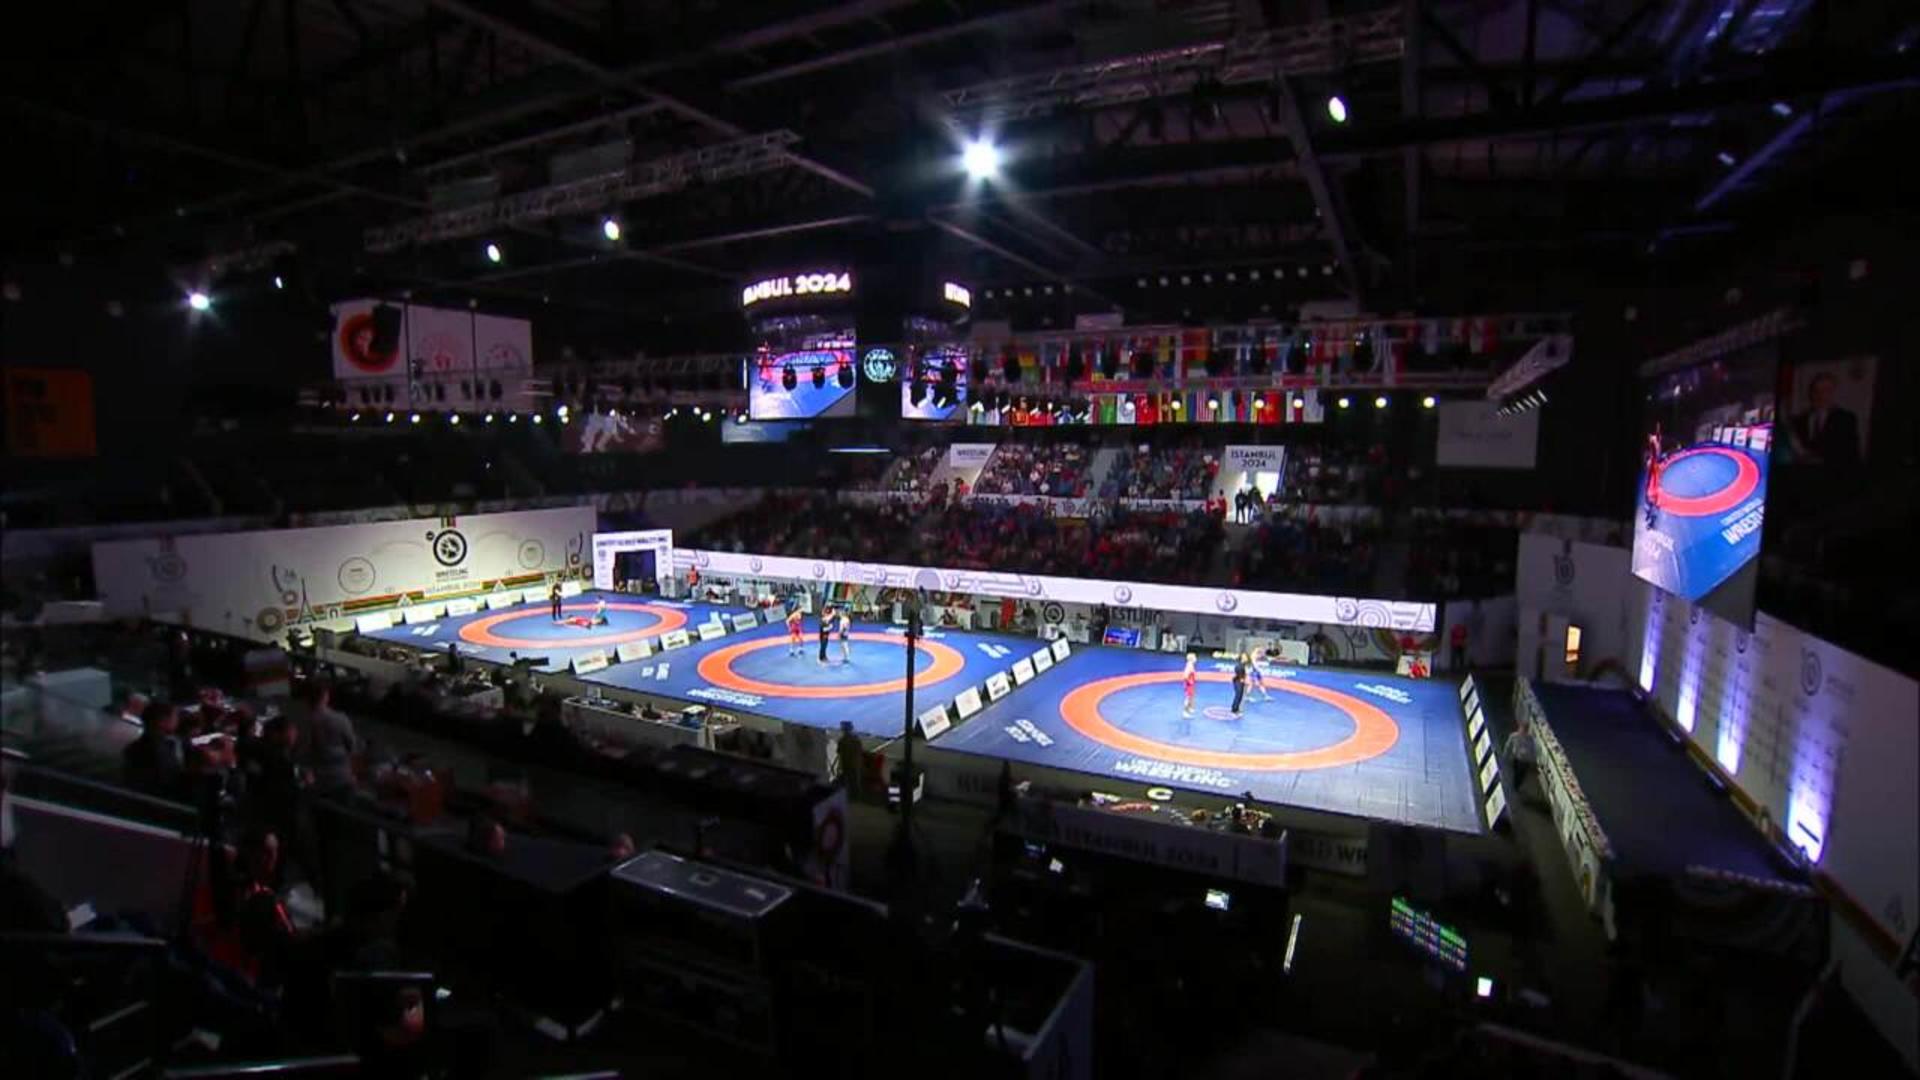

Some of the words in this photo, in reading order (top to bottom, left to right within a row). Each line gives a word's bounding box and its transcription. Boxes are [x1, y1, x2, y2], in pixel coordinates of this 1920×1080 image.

[795, 272, 851, 294] 2024
[1241, 459, 1266, 468] 2024
[1147, 787, 1173, 800] C
